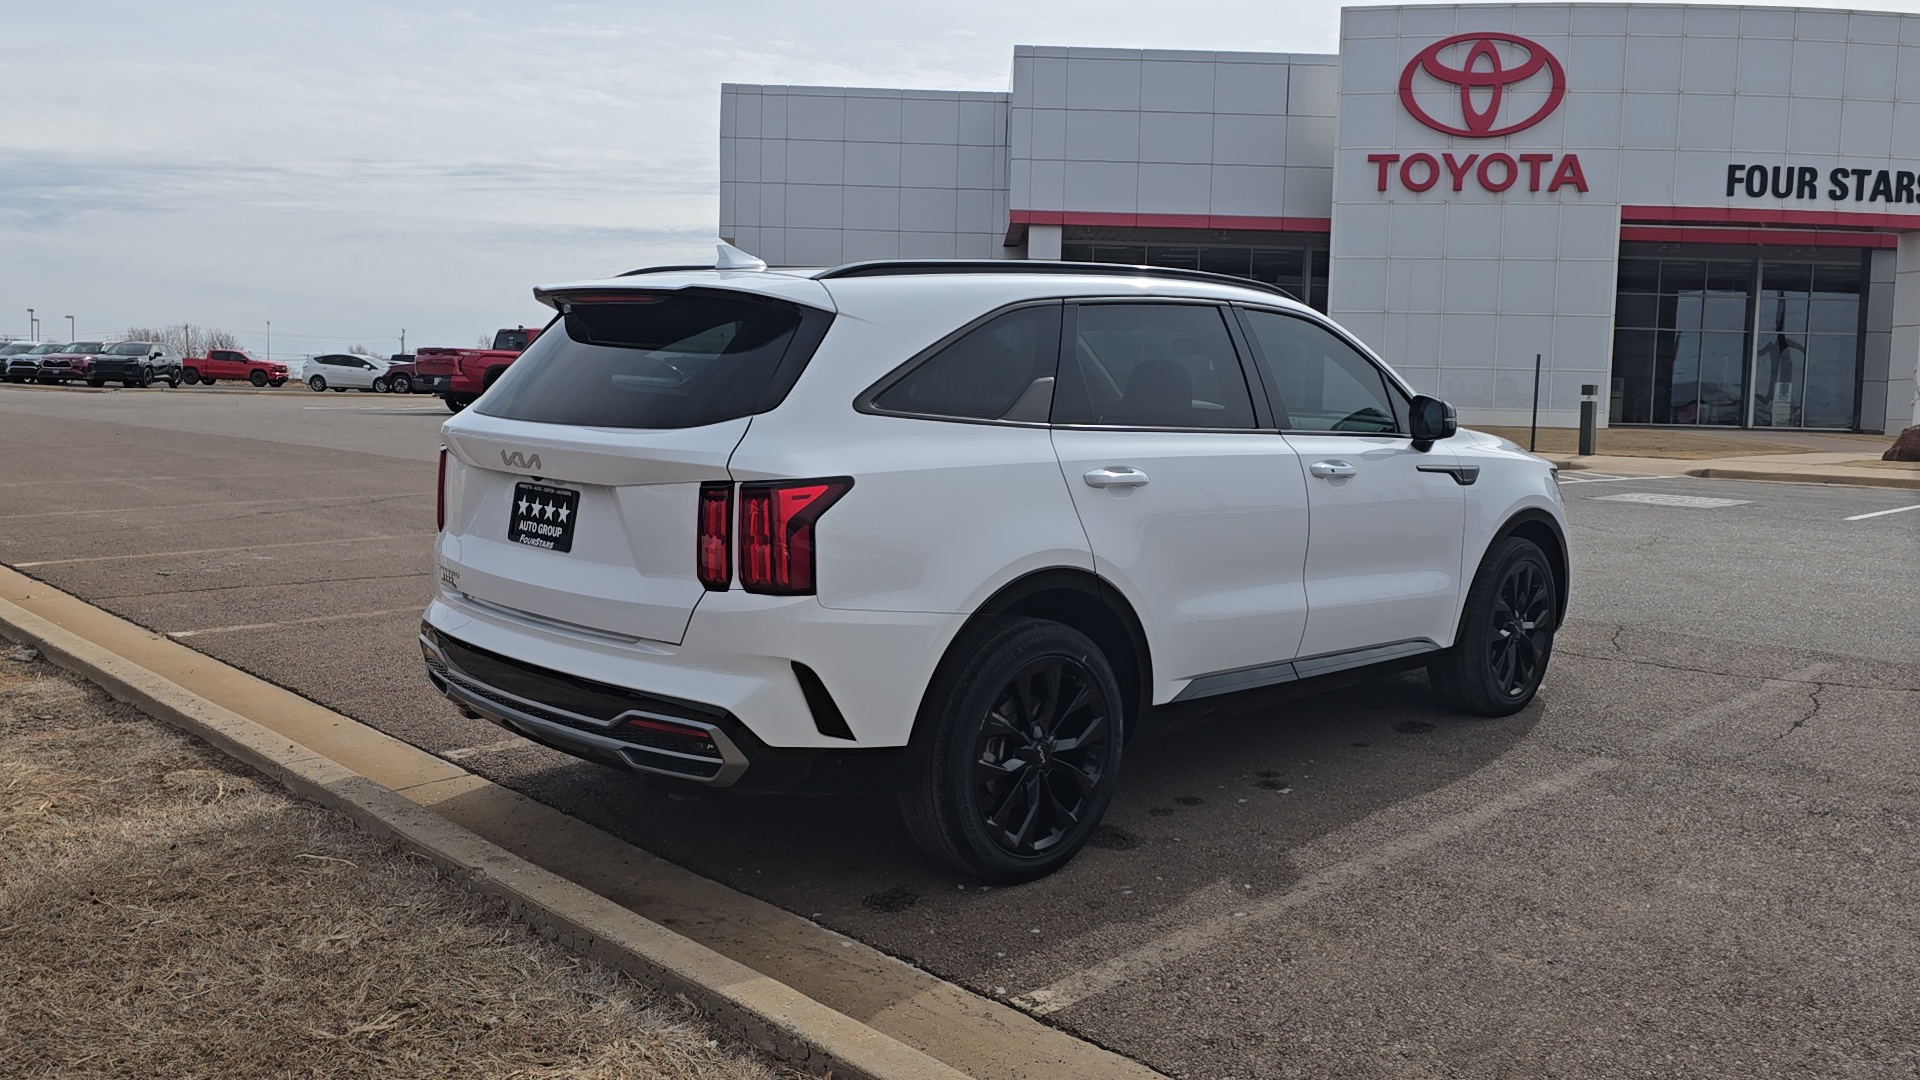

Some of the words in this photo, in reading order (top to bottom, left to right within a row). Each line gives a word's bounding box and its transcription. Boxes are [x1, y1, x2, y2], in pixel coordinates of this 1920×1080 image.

[1367, 152, 1590, 194] TOYOTA
[1726, 164, 1819, 199] FOUR
[1828, 167, 1920, 204] STAR
[518, 519, 538, 533] AUTO
[537, 523, 563, 538] GROUP
